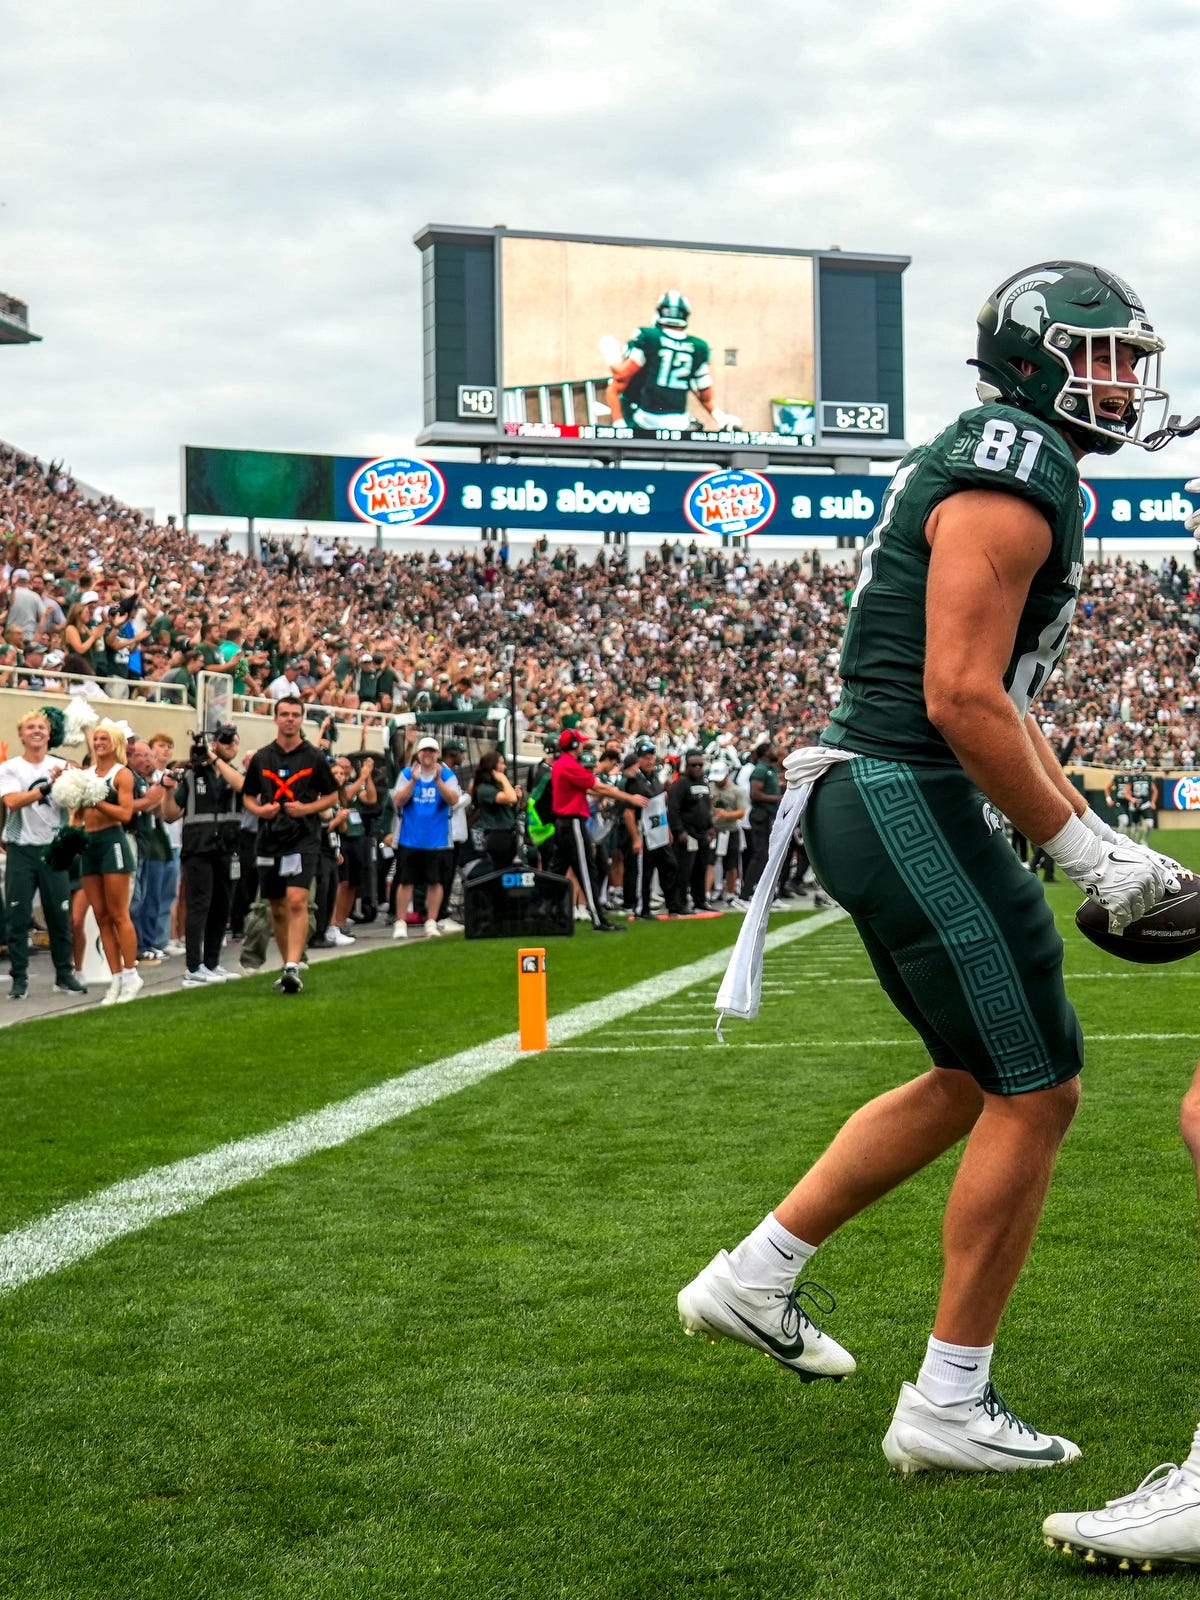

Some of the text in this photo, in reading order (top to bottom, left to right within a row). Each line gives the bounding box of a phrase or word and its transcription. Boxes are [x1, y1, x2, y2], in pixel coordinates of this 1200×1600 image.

[656, 348, 694, 390] 12
[462, 390, 493, 414] 40
[836, 406, 885, 430] 6:22
[972, 417, 1046, 483] 81
[363, 471, 430, 492] Jersey
[461, 484, 483, 510] a
[490, 479, 549, 512] sub
[698, 485, 761, 504] Jersey
[791, 489, 875, 520] a sub
[1111, 498, 1132, 522] a
[1139, 491, 1194, 522] sub
